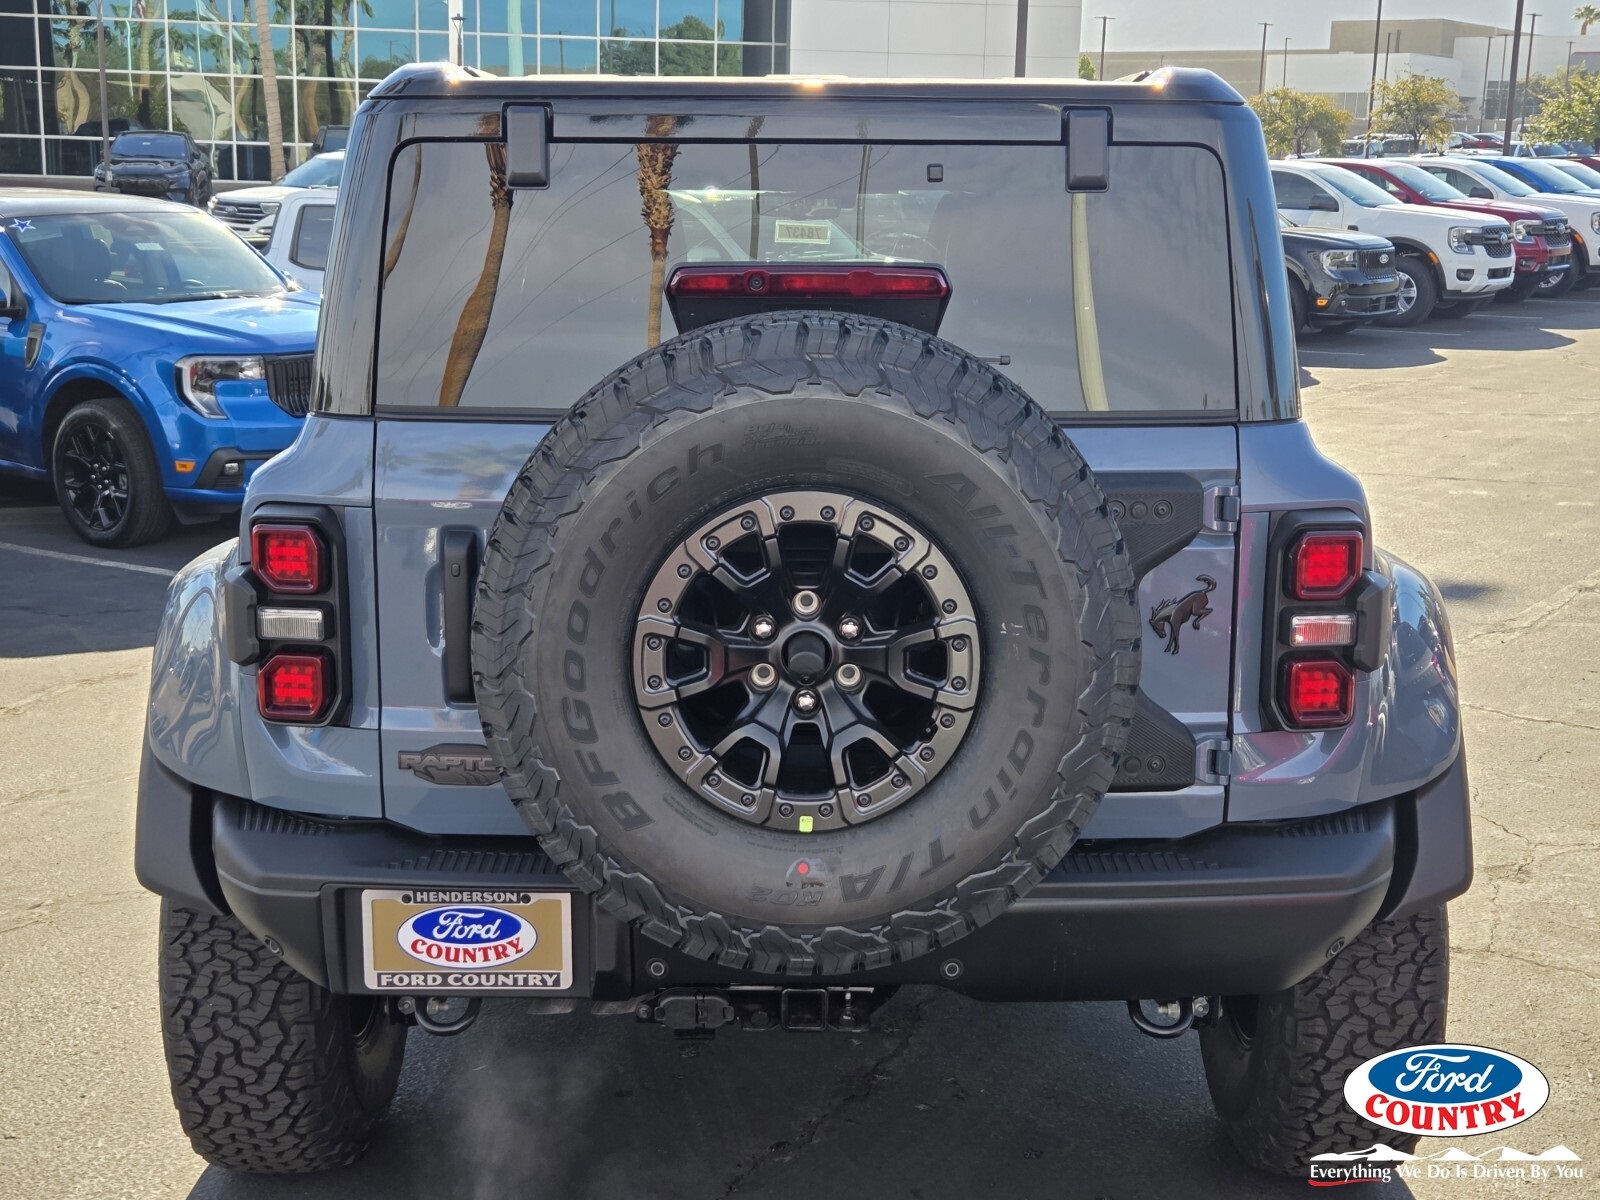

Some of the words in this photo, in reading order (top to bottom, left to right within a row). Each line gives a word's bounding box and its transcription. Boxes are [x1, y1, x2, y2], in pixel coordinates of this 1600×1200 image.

[562, 438, 727, 831] BFGoodrich
[922, 472, 1050, 831] All-Terrain
[840, 839, 955, 901] T/A
[416, 891, 518, 903] HENDERSON
[432, 911, 502, 940] Ford
[410, 937, 524, 963] COUNTRY
[380, 973, 443, 987] FORD
[447, 973, 558, 987] COUNTRY
